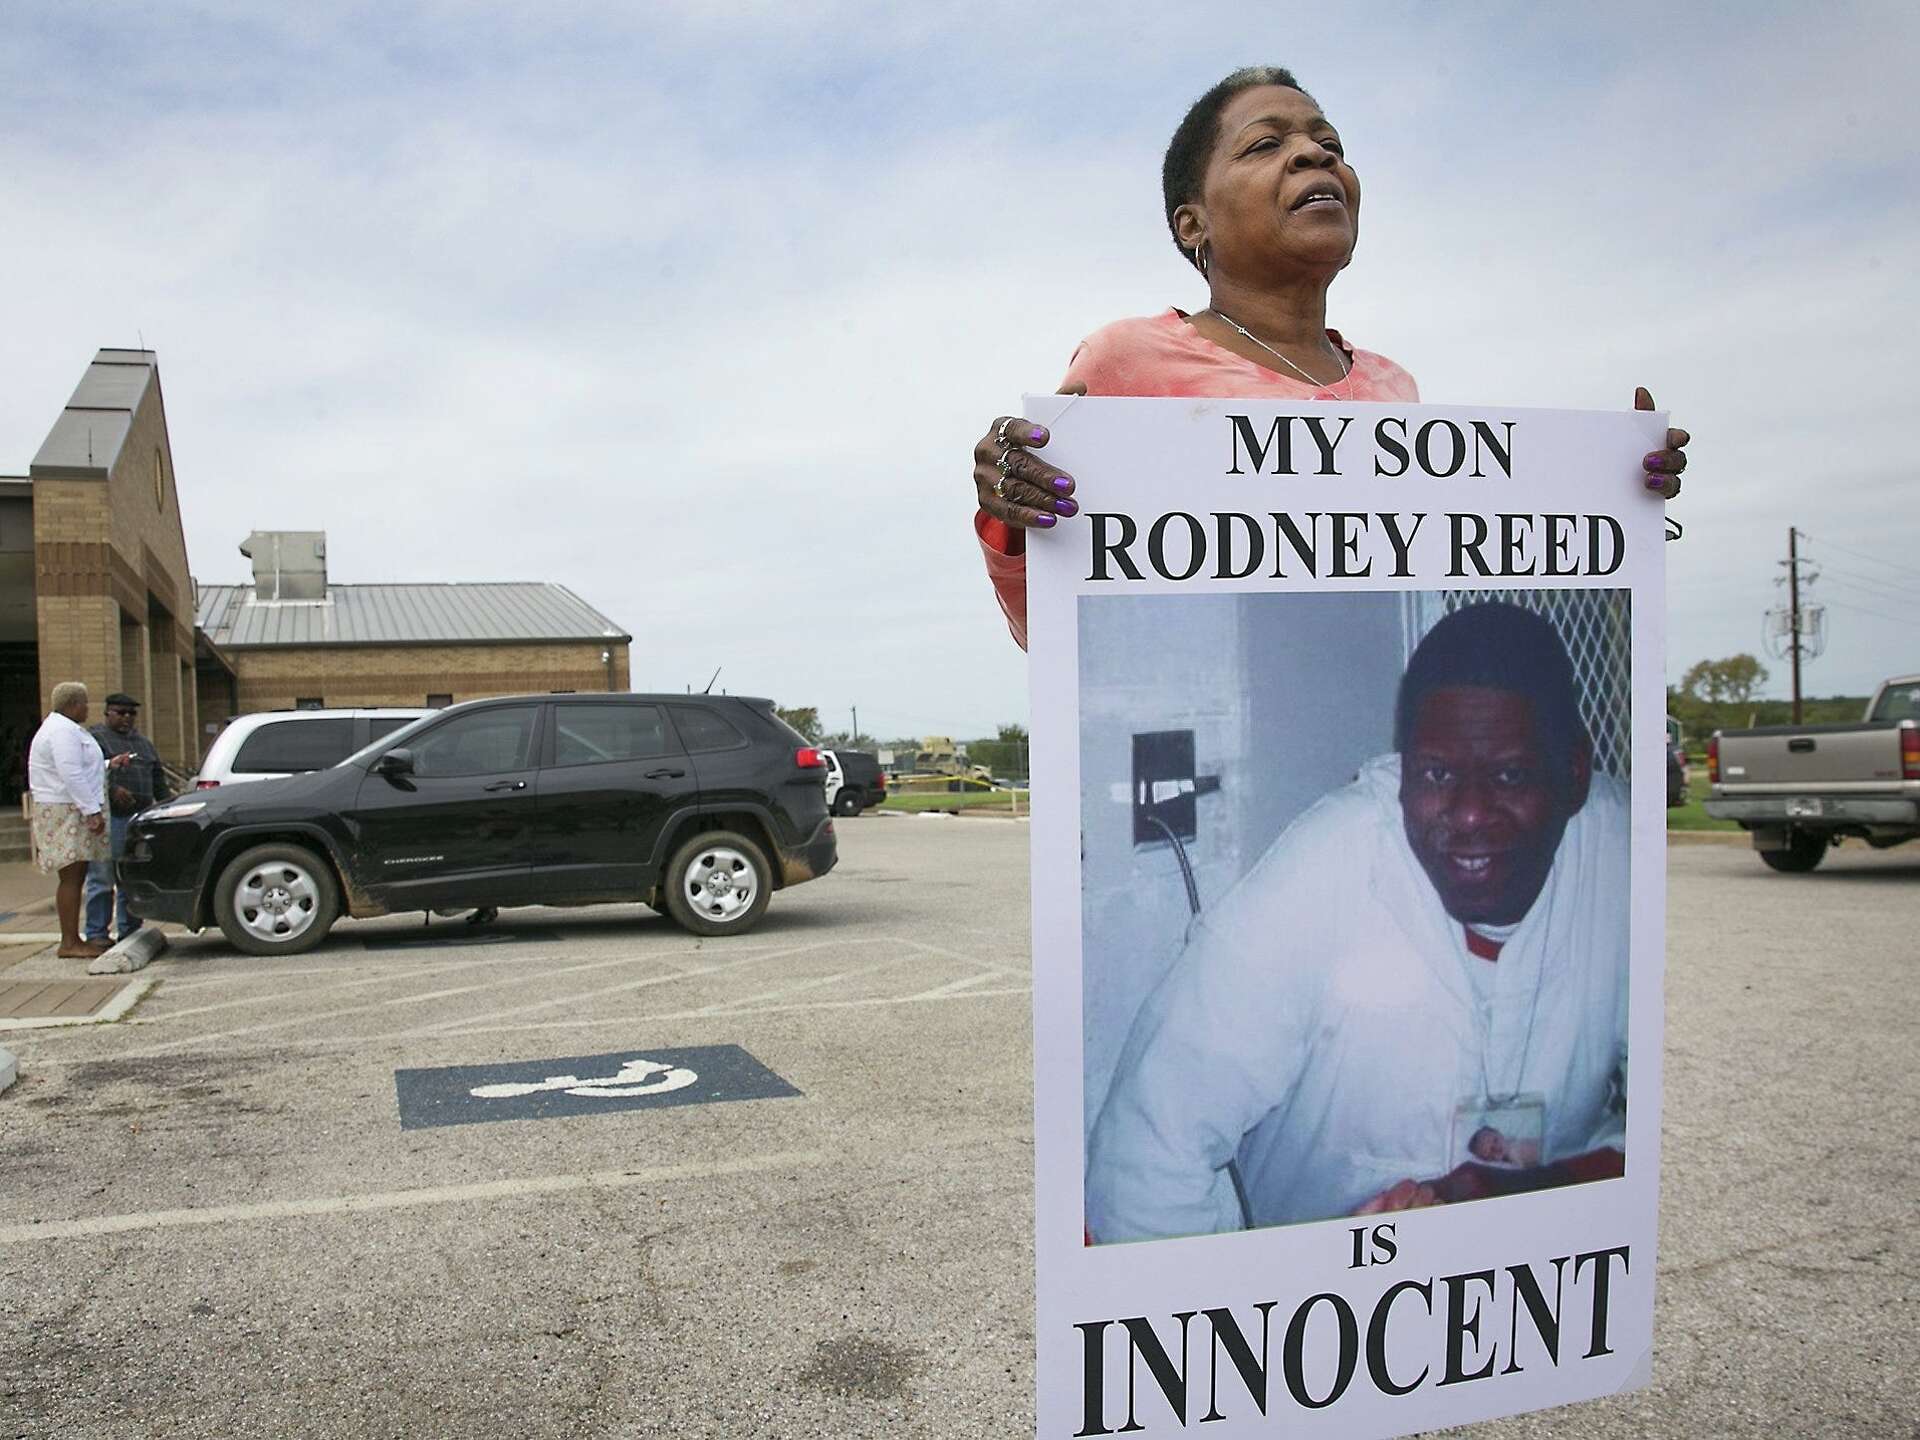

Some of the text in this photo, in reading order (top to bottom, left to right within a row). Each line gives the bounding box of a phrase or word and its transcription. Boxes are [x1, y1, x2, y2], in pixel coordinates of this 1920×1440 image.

[1225, 416, 1517, 479] MY SON
[1084, 512, 1625, 581] RODNEY REED
[1348, 1223, 1398, 1269] IS
[1073, 1246, 1631, 1438] INNOCENT
